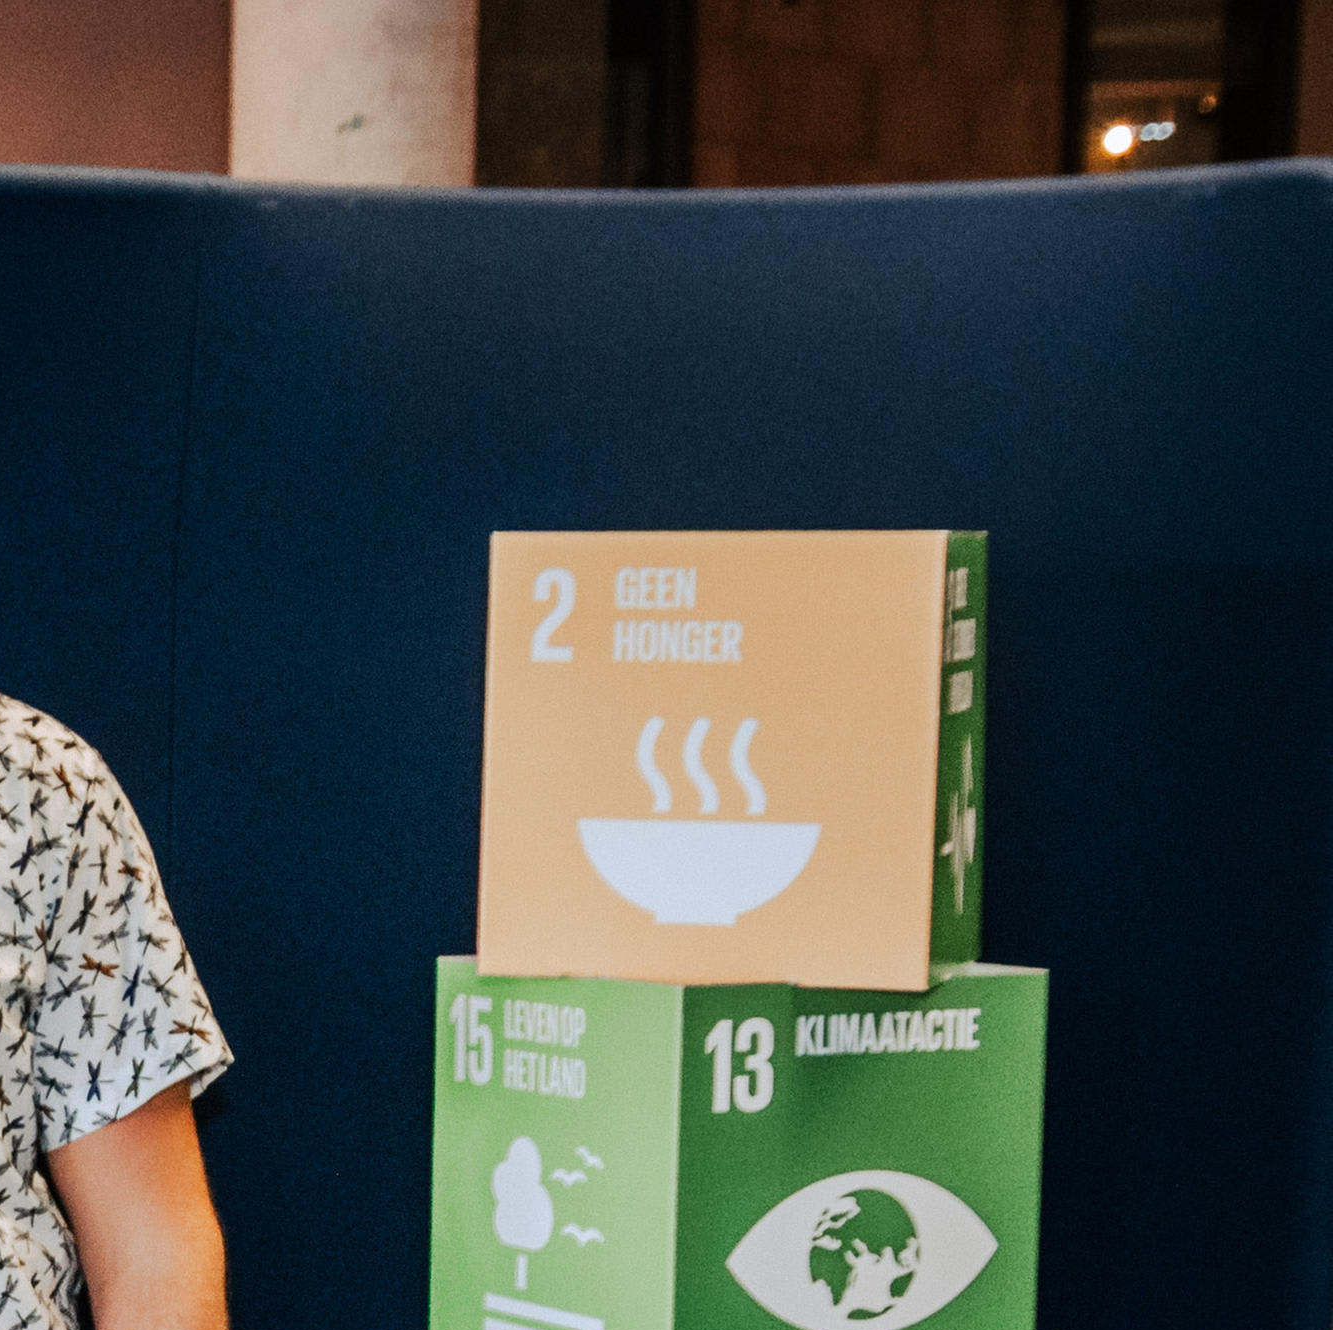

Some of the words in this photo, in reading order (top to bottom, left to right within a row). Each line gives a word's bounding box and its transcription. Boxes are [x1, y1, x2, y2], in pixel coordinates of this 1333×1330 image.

[613, 566, 697, 610] GEEN
[530, 567, 576, 663] 2
[612, 620, 743, 663] HONGER
[449, 993, 494, 1085] 15
[503, 999, 559, 1045] LEVEN
[560, 1005, 586, 1048] OP
[795, 1007, 982, 1057] KLIMAATACTIE
[503, 1049, 537, 1092] HET
[538, 1053, 586, 1099] LAND
[704, 1016, 775, 1114] 13
